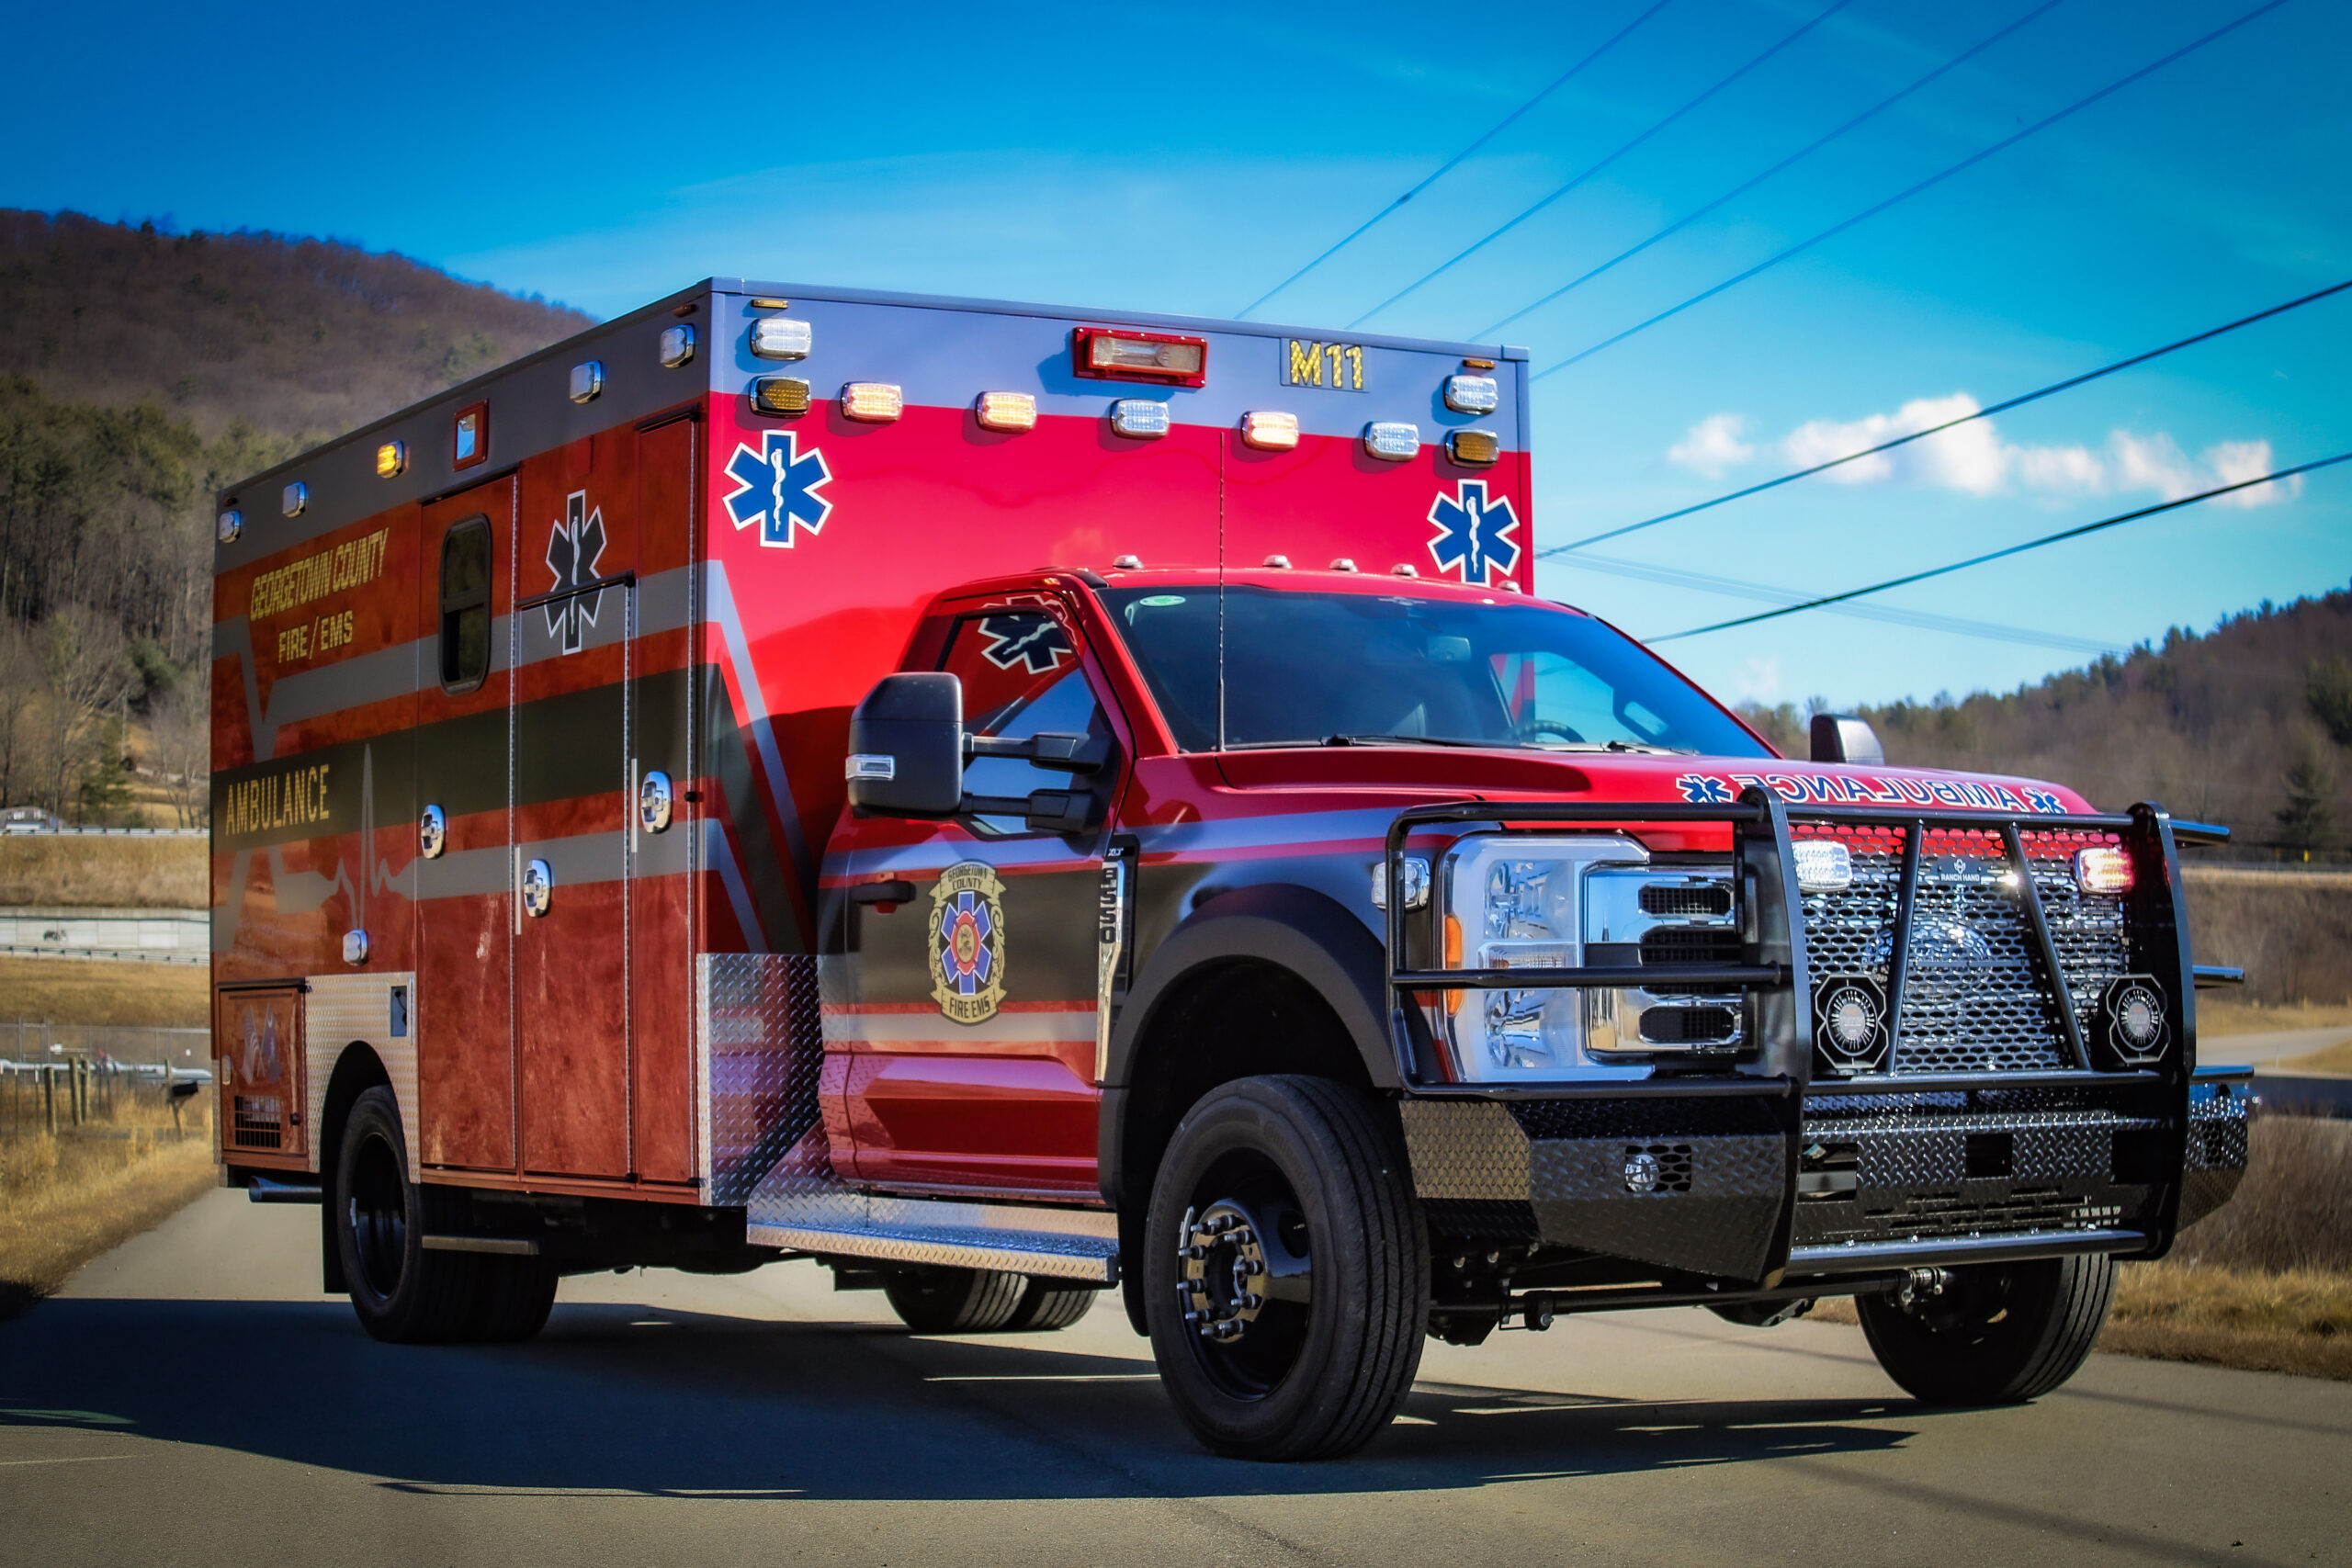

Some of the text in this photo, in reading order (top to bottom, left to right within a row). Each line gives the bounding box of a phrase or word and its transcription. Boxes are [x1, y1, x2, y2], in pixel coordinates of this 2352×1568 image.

[1290, 340, 1363, 390] M11
[250, 527, 390, 622] GEORGETOWN COUNTY
[225, 763, 330, 836] AMBULANCE
[947, 863, 988, 882] GEORGETOWN
[952, 877, 982, 891] COUNTY
[1940, 874, 1980, 882] RANCH HAND
[949, 995, 991, 1019] FIRE EMS
